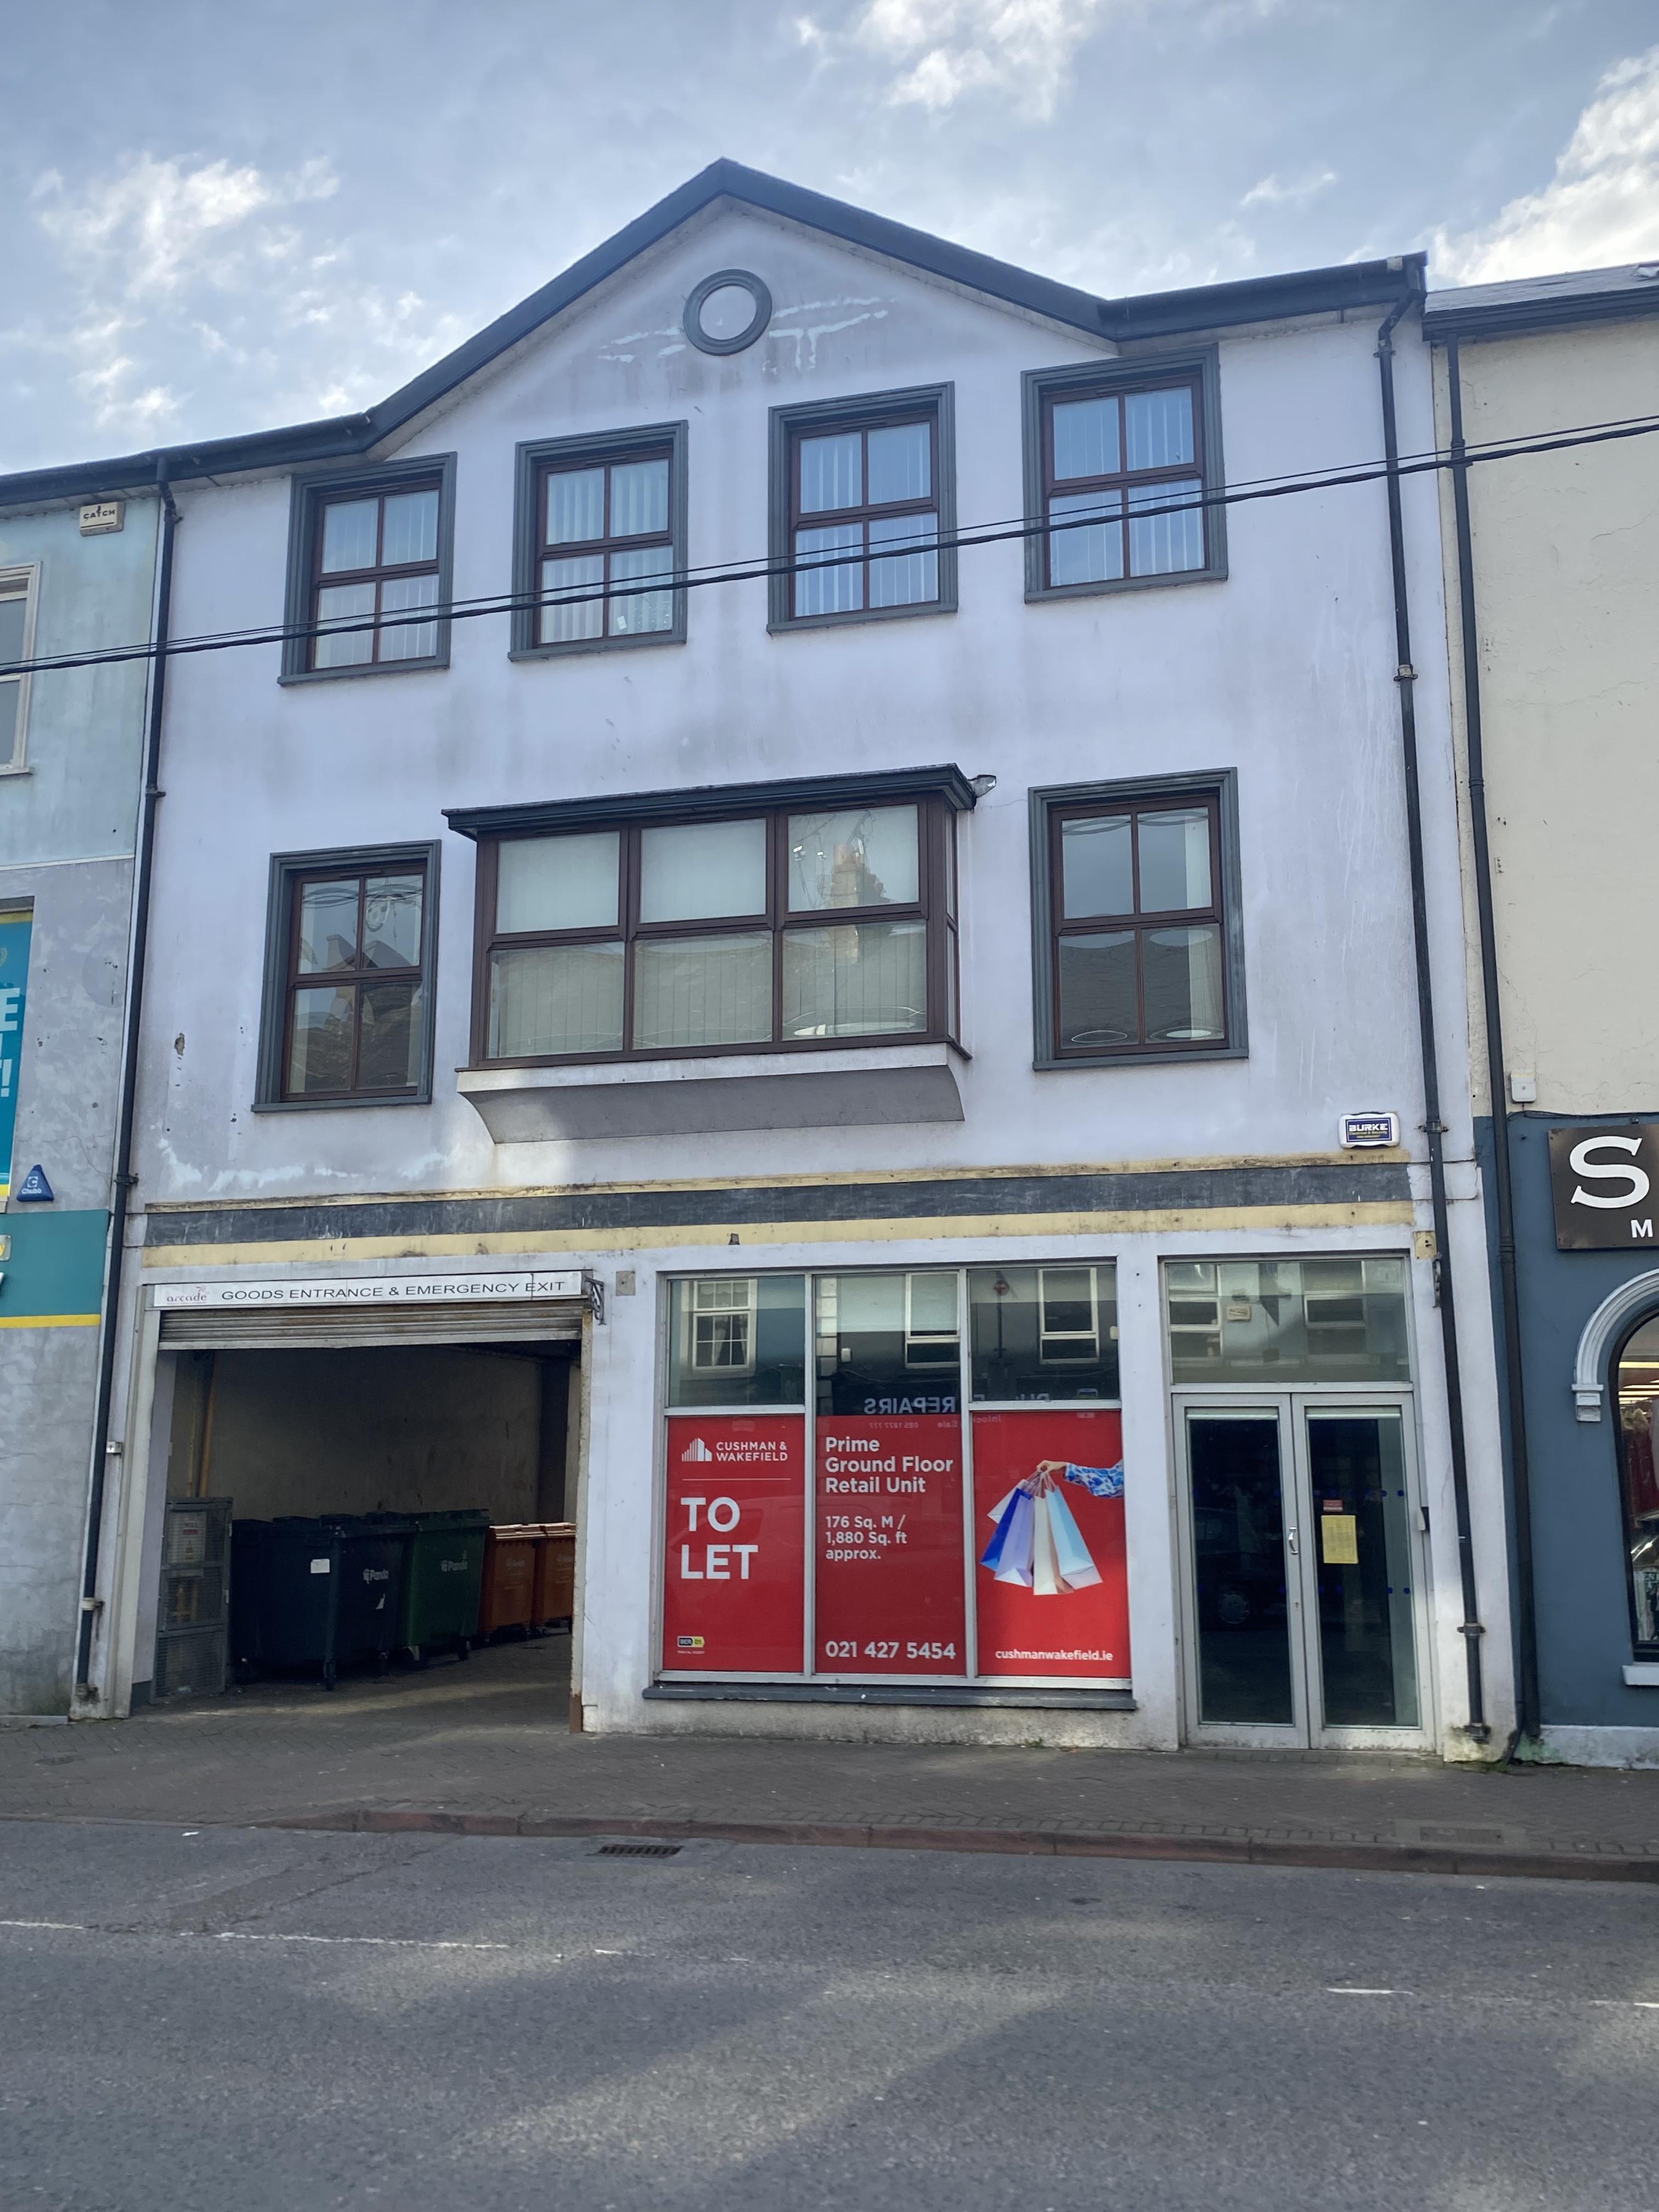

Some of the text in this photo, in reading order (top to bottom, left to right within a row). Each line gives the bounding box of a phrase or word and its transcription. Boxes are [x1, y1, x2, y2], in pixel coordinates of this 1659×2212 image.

[83, 509, 115, 520] CATCH
[1348, 1123, 1388, 1132] BURKE
[1569, 1136, 1650, 1209] S
[1630, 1219, 1654, 1238] M
[167, 1293, 207, 1302] arcade
[222, 1281, 566, 1300] GOODS ENTRANCE & EMERGENCY EXIT
[716, 1441, 787, 1451] CUSHMAN &
[825, 1436, 880, 1452] Prime
[716, 1452, 788, 1462] WAKEFIELD
[825, 1455, 953, 1472] Ground Floor
[825, 1476, 926, 1493] Retail Unit
[680, 1497, 741, 1532] TO
[825, 1514, 906, 1530] 176 Sq. M /
[825, 1531, 907, 1546] 1,880 Sq. ft
[681, 1544, 759, 1579] LET
[825, 1549, 881, 1562] approx.
[825, 1640, 956, 1660] 021 427 5454
[995, 1649, 1114, 1661] cushmanwakefield.ie
